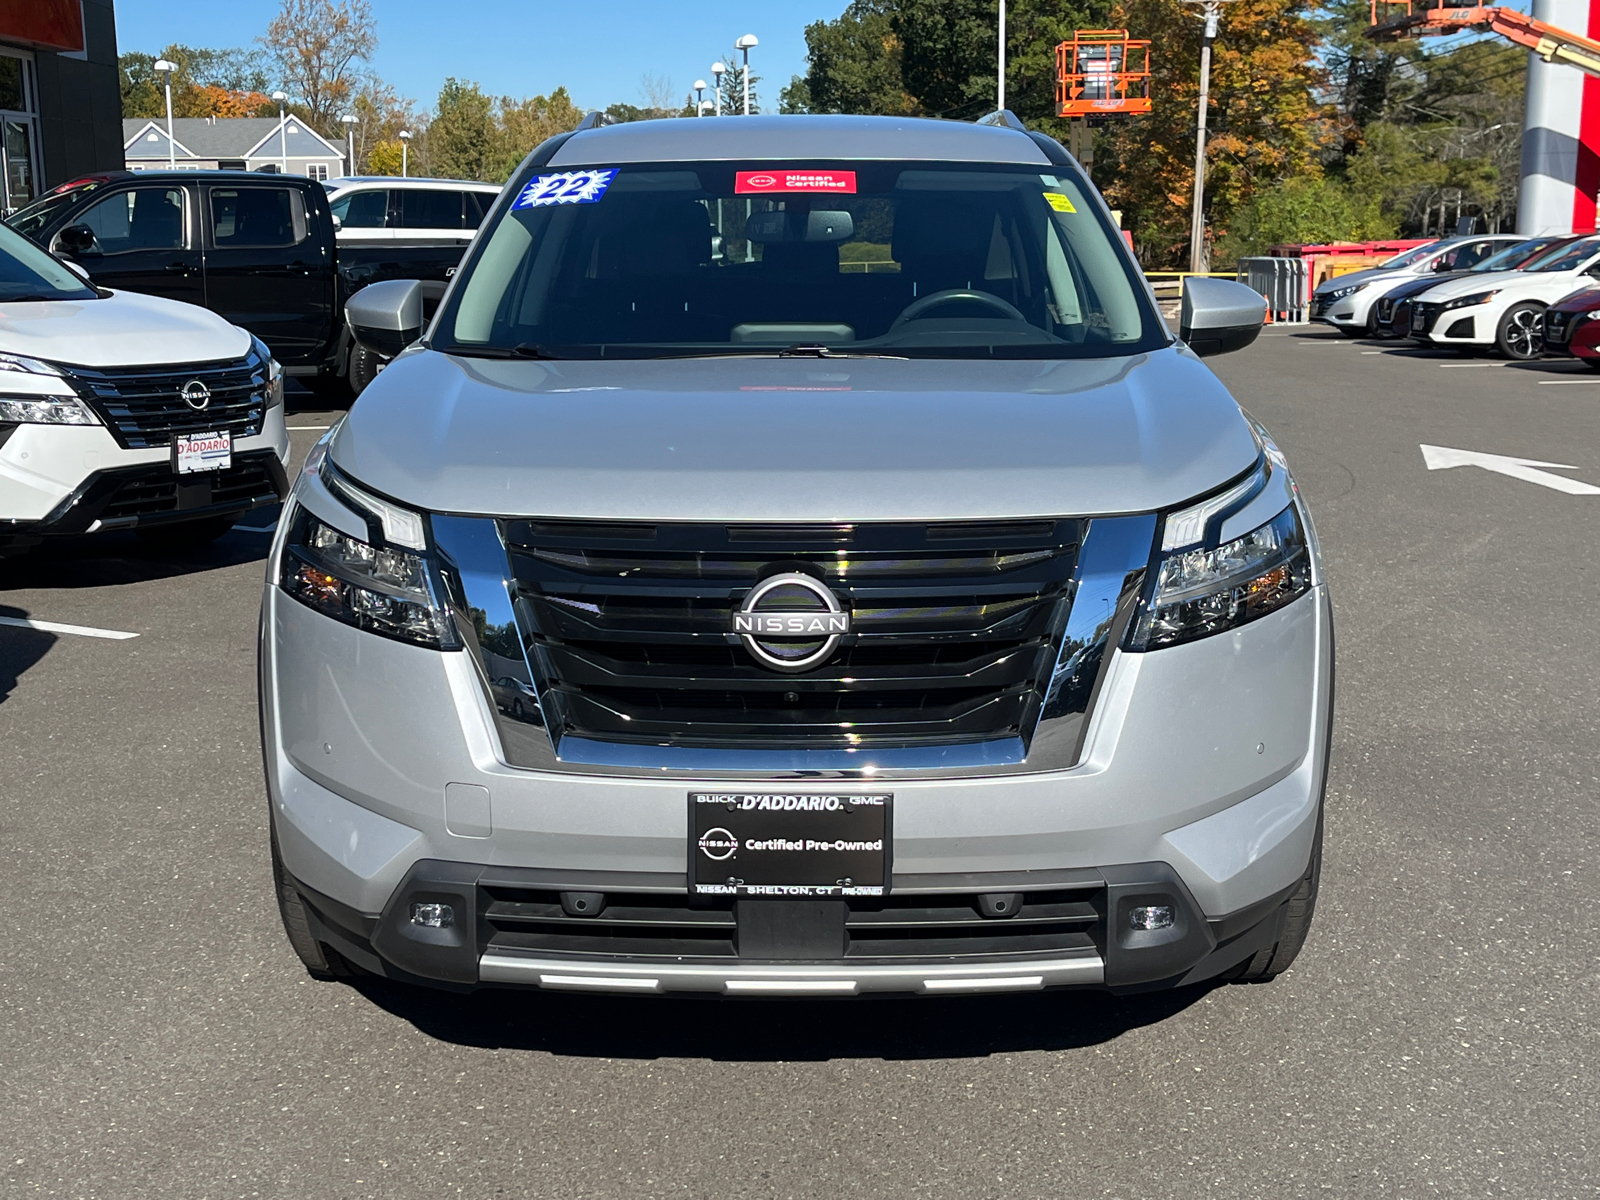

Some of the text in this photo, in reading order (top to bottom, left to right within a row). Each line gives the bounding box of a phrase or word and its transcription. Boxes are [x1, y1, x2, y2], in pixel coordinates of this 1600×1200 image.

[1449, 11, 1470, 19] JLG
[536, 176, 591, 200] 22
[181, 391, 211, 399] NISSAN
[177, 439, 230, 455] D'ADDARIO
[735, 616, 846, 632] NISSAN
[696, 795, 885, 811] BUICK D'ADDARIO GMC
[698, 838, 883, 851] NISSAN Certified Pre-Owned
[696, 886, 883, 896] NISSAN SHELTON, CT PRE-OWNED
